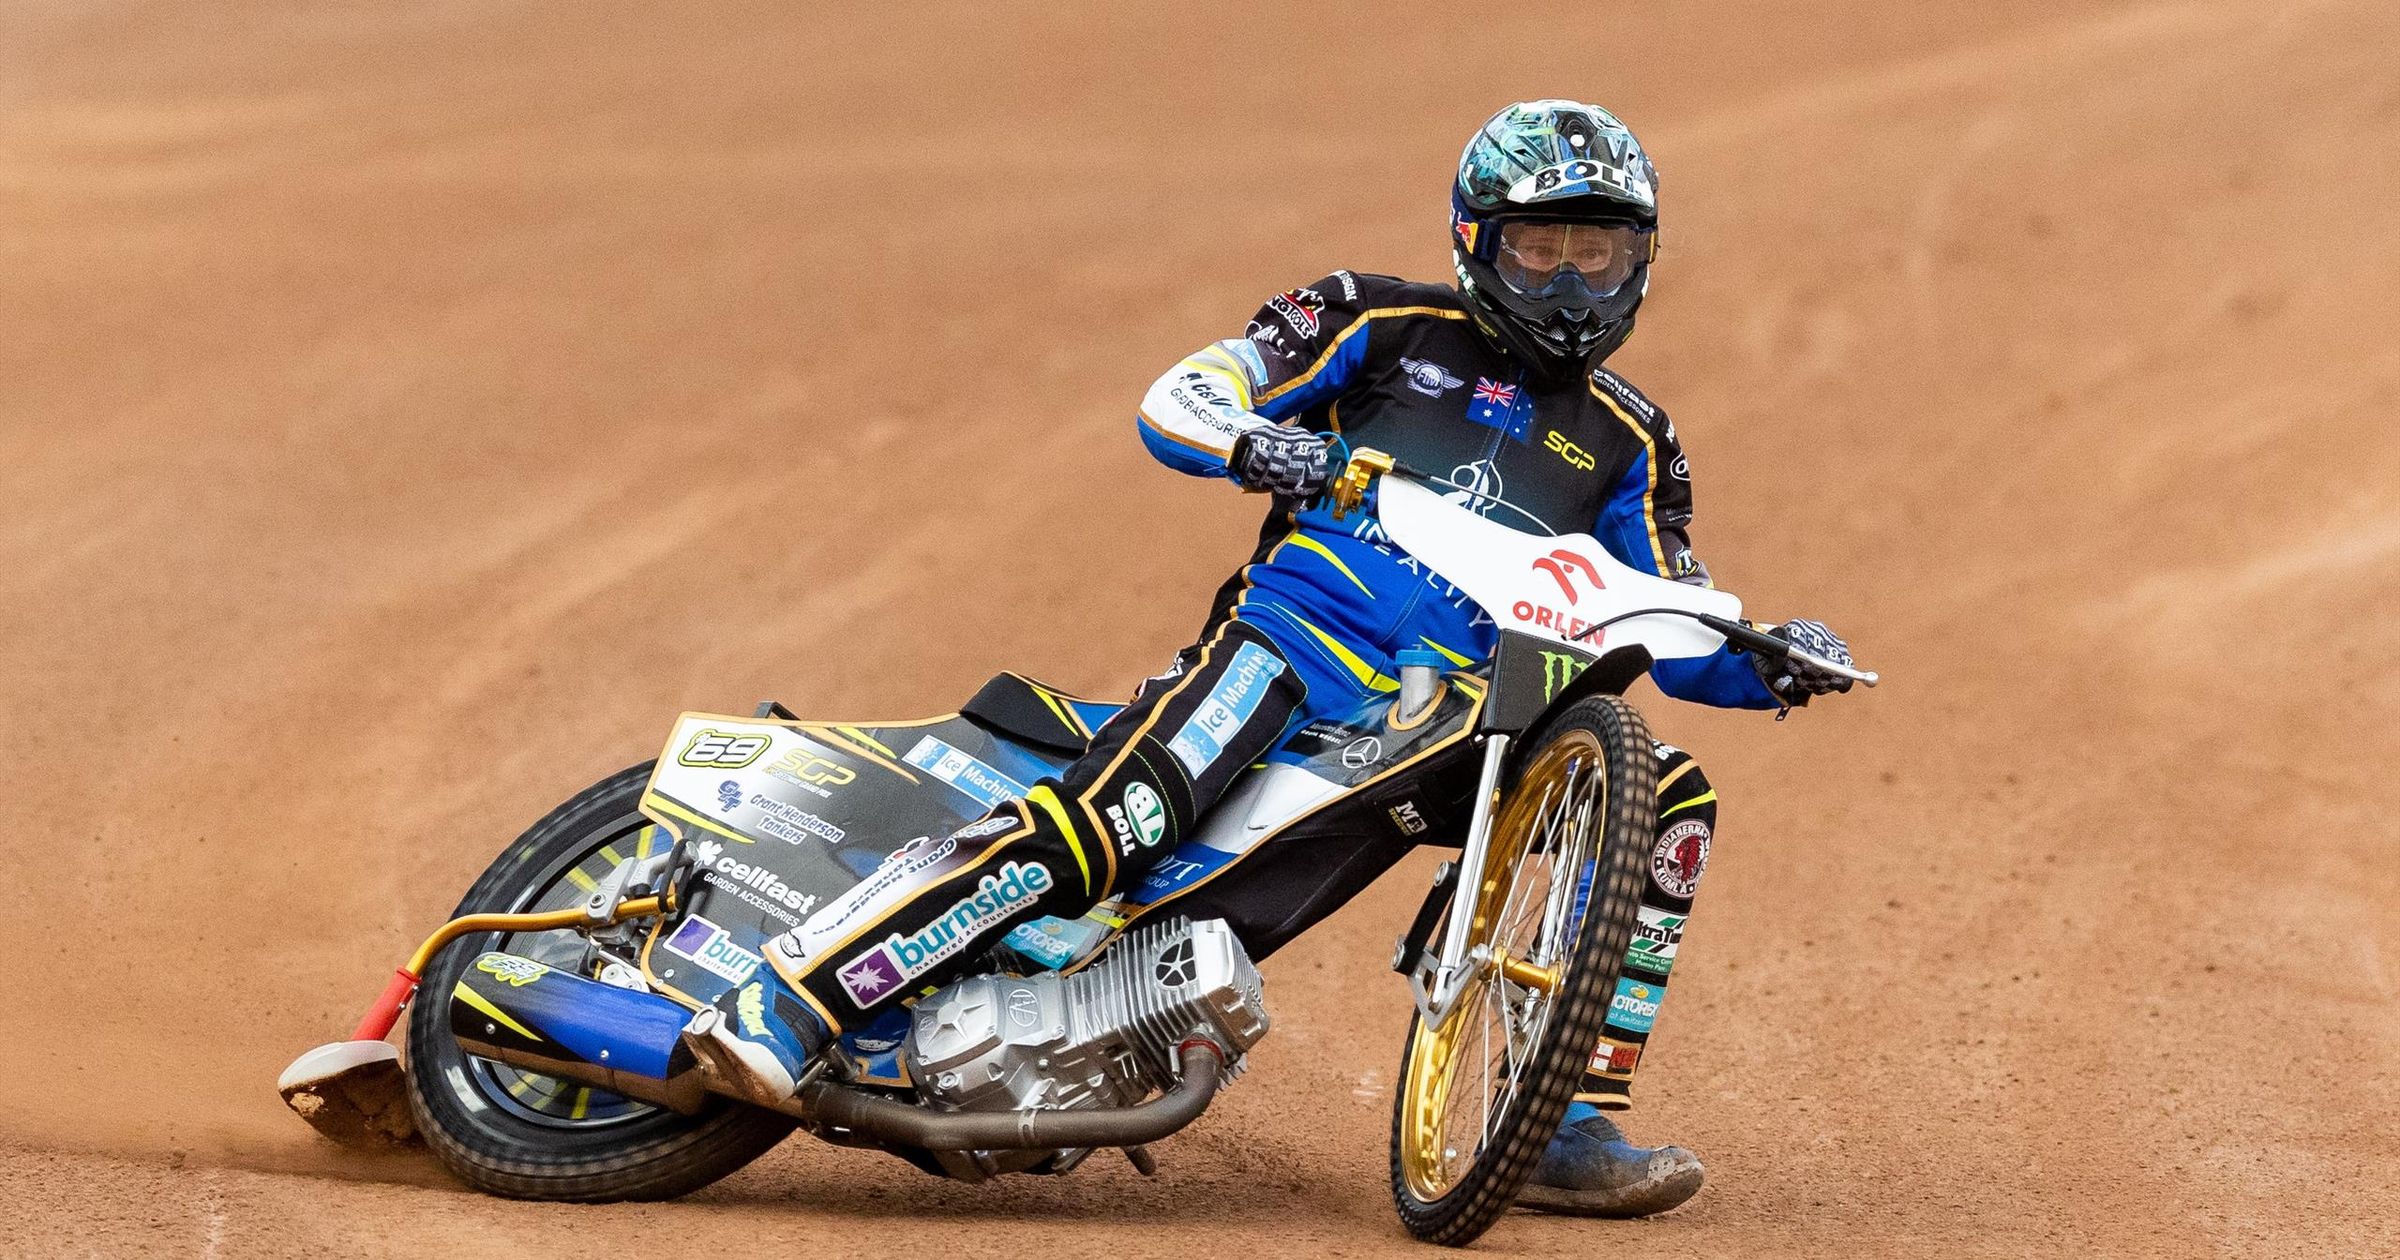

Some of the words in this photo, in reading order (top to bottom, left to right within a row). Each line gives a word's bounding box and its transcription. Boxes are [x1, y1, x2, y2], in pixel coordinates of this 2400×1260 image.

[1543, 430, 1595, 471] SGP
[1512, 600, 1606, 648] ORLEN
[1201, 706, 1228, 733] Ice
[679, 730, 771, 768] 69
[771, 747, 856, 785] SGP
[941, 757, 961, 773] Ice
[750, 793, 783, 814] Grant
[780, 805, 844, 843] Henderson
[758, 816, 803, 844] Tankers
[1106, 803, 1136, 857] BOLL
[1655, 824, 1705, 858] INDIANERNA
[704, 872, 741, 896] GARDEN
[738, 889, 800, 928] ACCESSORIES
[716, 857, 816, 915] cellfast
[1656, 867, 1688, 894] KUMLA
[889, 865, 1049, 969] burnside
[911, 935, 964, 976] chartered
[965, 896, 1034, 936] accountants
